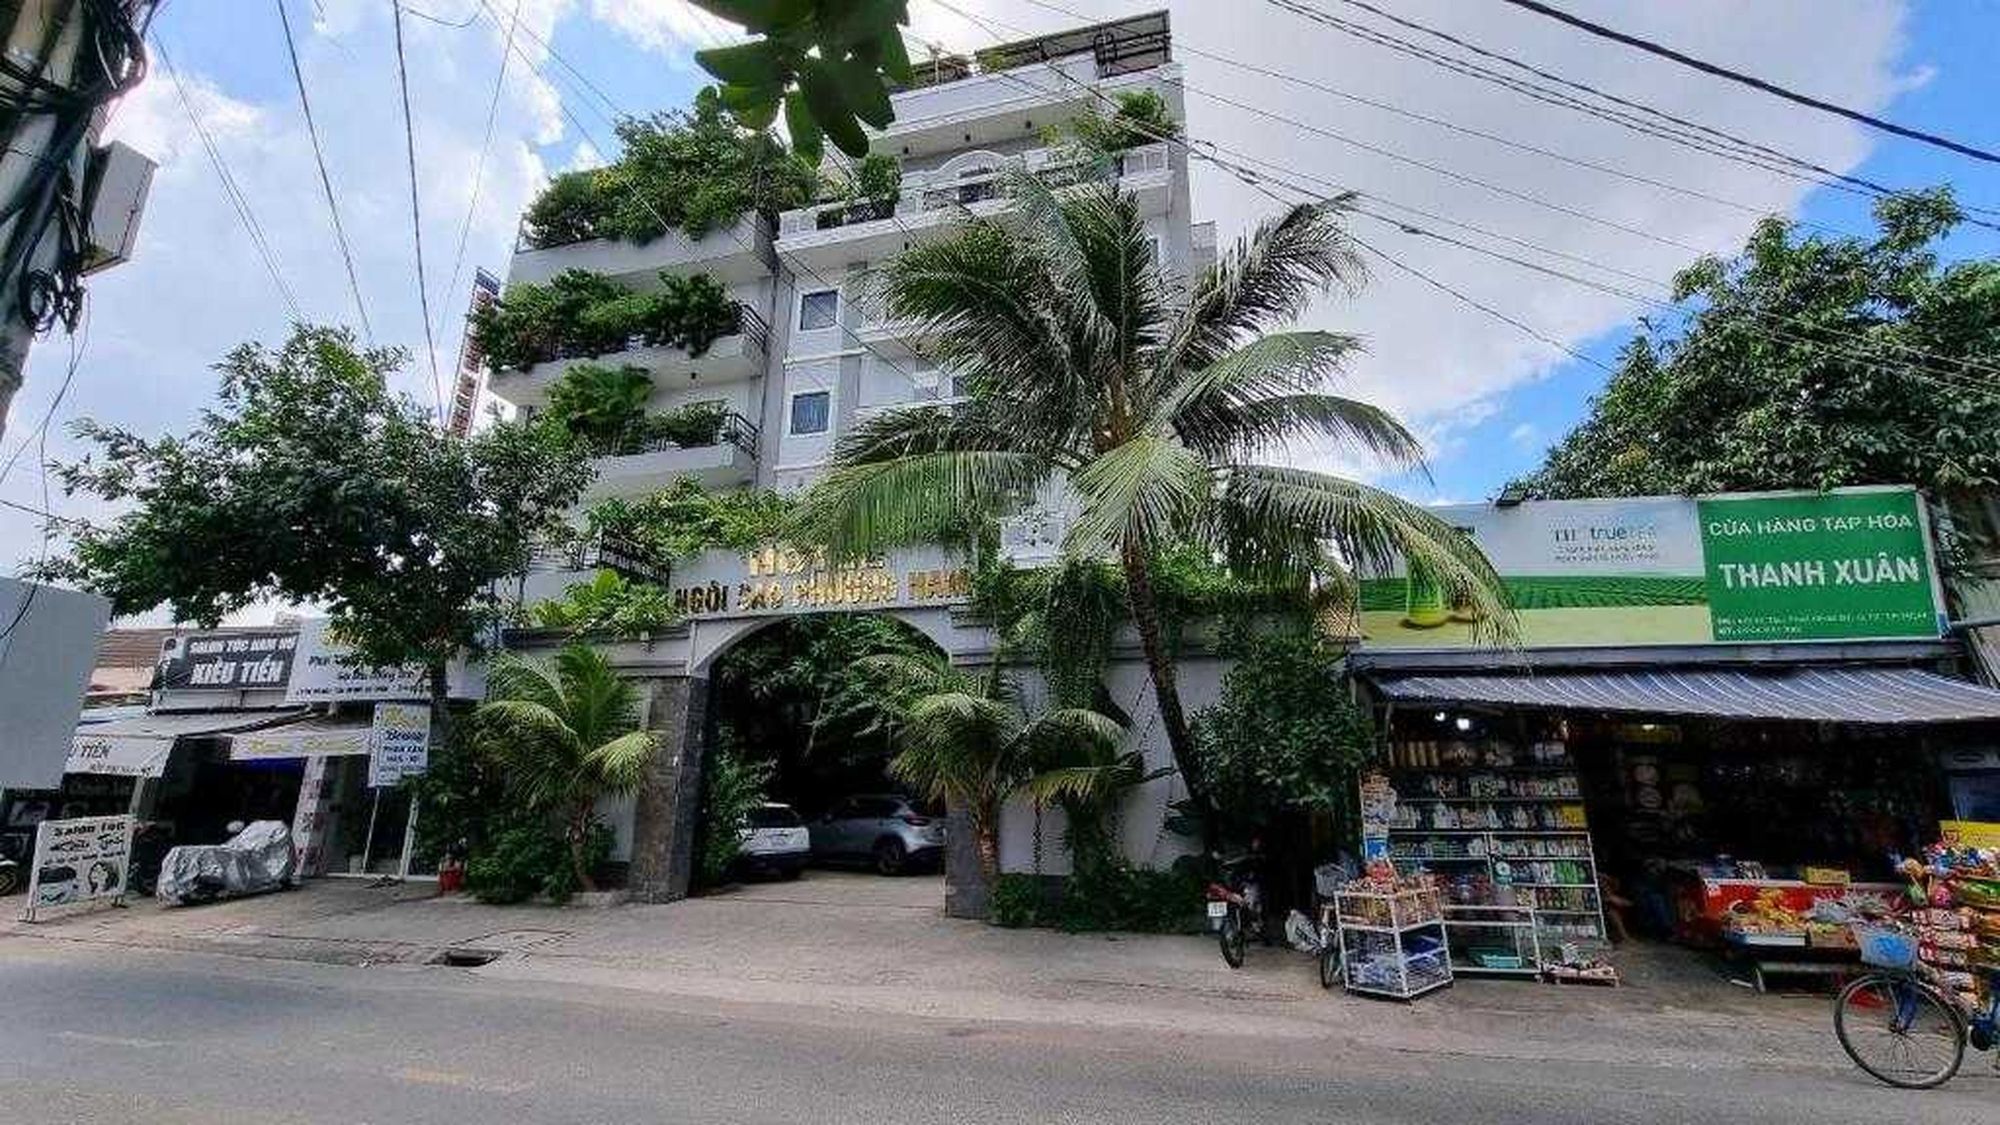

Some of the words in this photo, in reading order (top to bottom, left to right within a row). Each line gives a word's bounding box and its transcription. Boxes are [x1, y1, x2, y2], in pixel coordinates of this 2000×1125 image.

[1757, 516, 1816, 534] HÀNG
[1719, 561, 1825, 588] THANH
[1834, 552, 1919, 584] XUÂN
